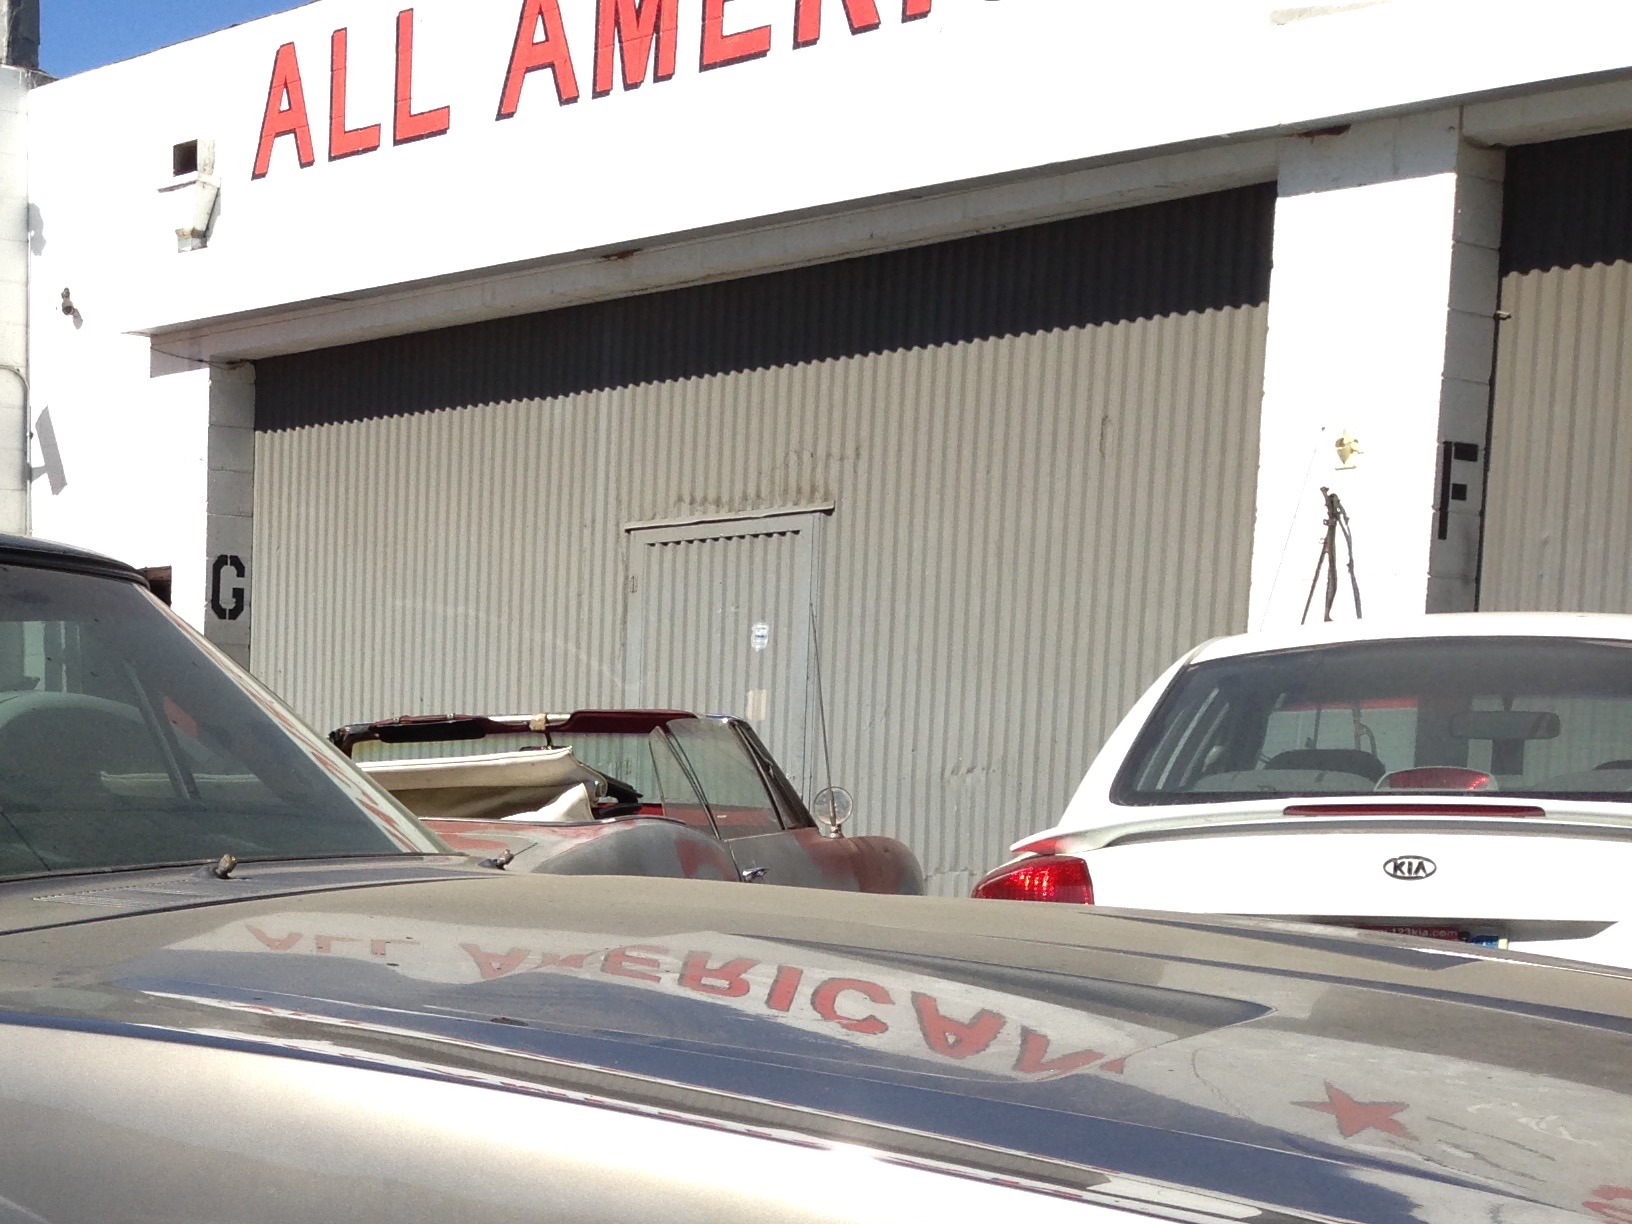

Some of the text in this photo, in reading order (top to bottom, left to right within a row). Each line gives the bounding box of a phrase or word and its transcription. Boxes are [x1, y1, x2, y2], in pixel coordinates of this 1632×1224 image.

[252, 9, 452, 179] ALL
[211, 554, 245, 620] G
[1392, 860, 1428, 876] KIA
